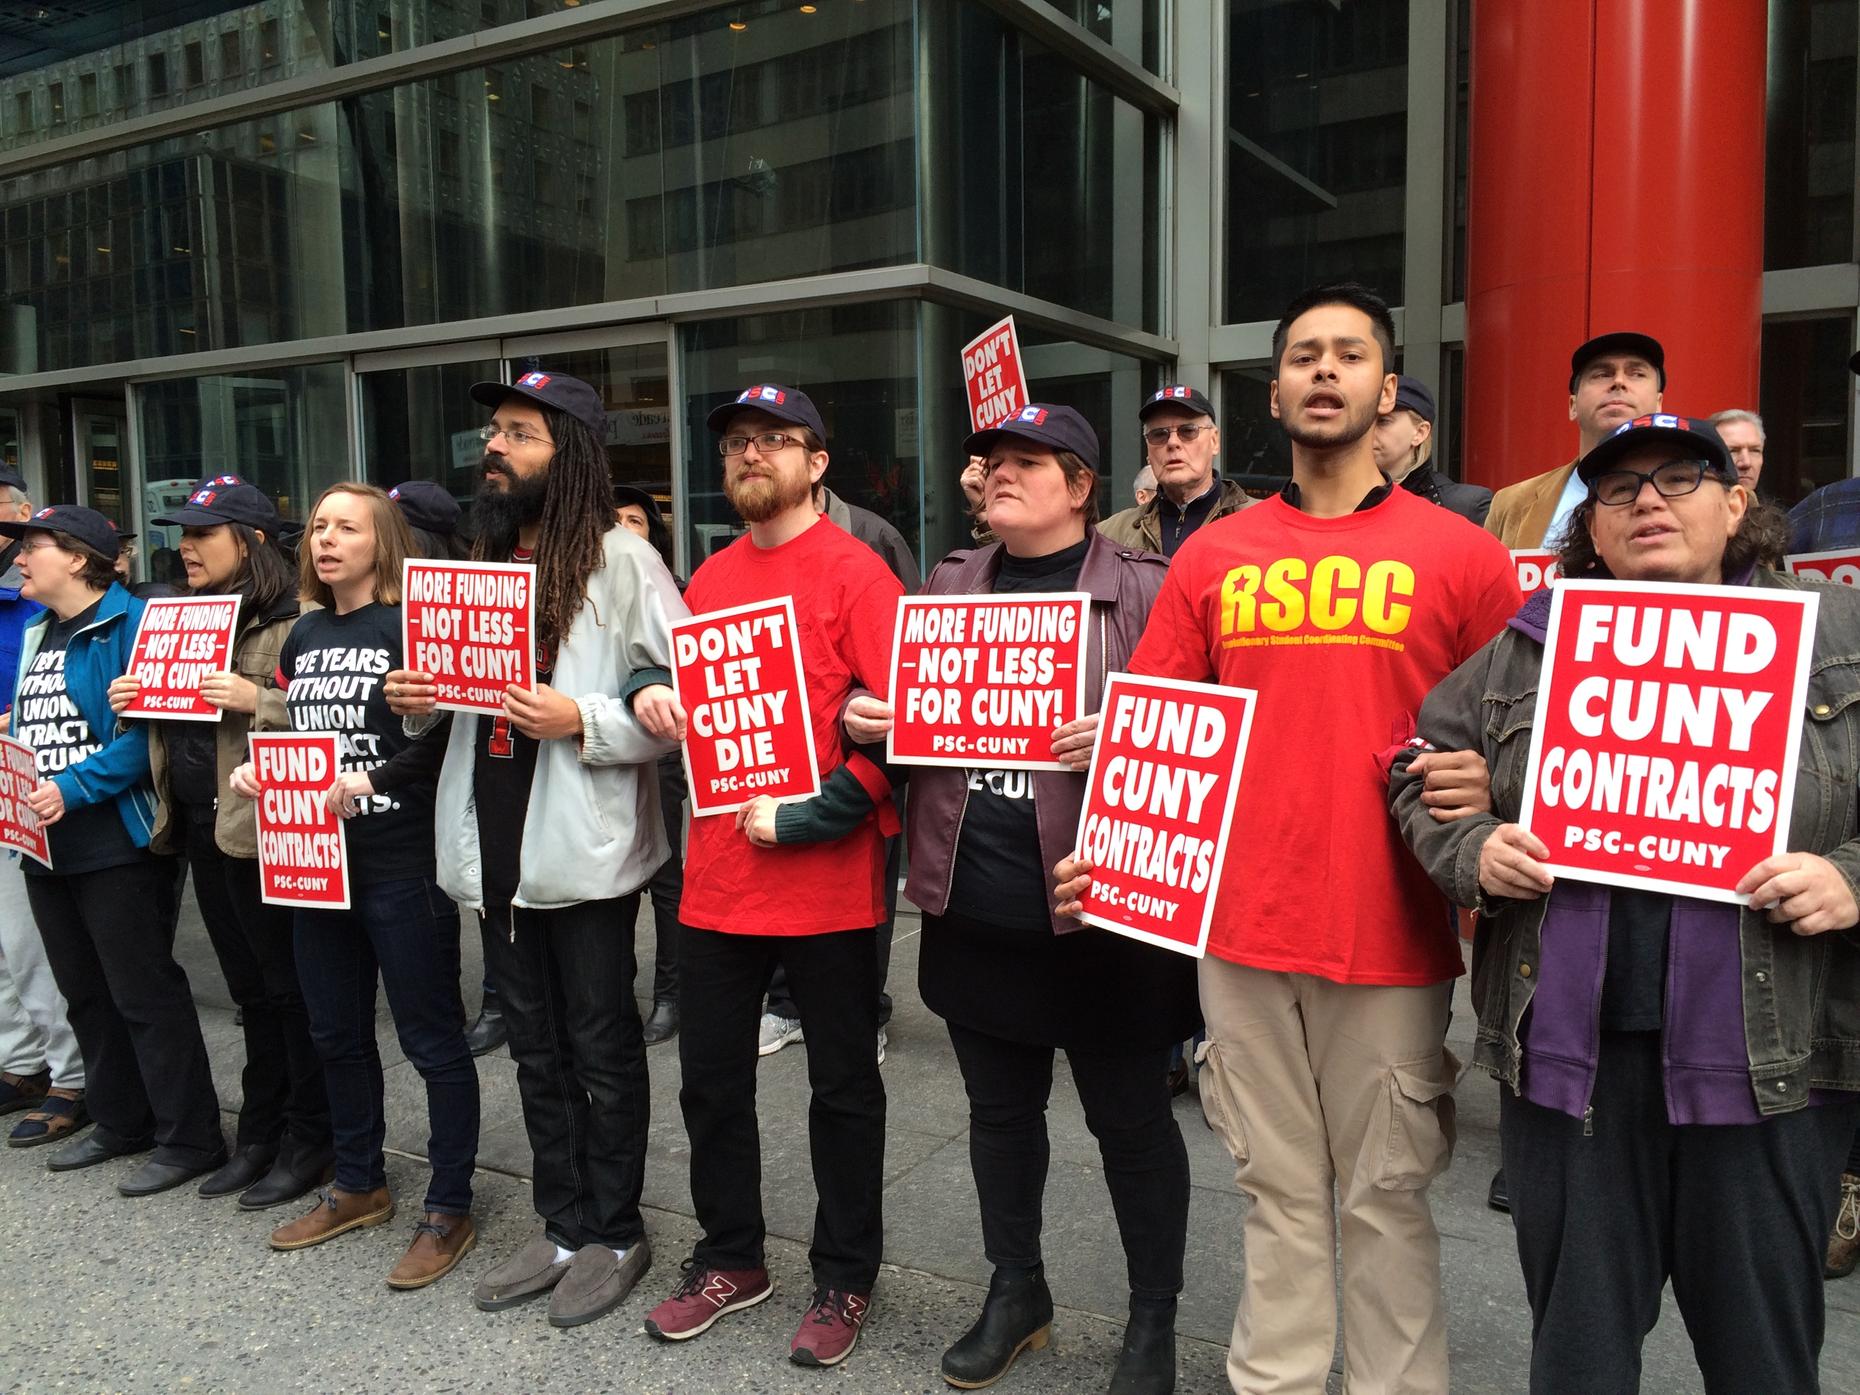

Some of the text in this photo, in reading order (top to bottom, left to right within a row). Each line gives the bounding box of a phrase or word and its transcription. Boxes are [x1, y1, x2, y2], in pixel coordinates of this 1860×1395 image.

[966, 330, 1010, 381] DON'T
[978, 364, 1002, 400] LET
[976, 385, 1016, 428] CUNY
[410, 570, 527, 609] MORE FUNDING
[1221, 556, 1415, 636] RSCC
[143, 604, 232, 631] MORE FUNDING
[904, 605, 1076, 643] MORE FUNDING
[676, 613, 784, 667] DON'T
[1574, 604, 1777, 674] FUND
[135, 662, 165, 688] FOR
[321, 648, 390, 674] YEARS
[416, 642, 455, 675] FOR
[460, 646, 522, 682] CUNY!
[704, 656, 762, 699] LET
[24, 695, 78, 721] UNION
[143, 696, 195, 710] PSC-CUNY
[438, 684, 502, 703] PSC-CUNY
[906, 688, 1063, 728] FOR CUNY!
[295, 705, 365, 731] UNION
[693, 690, 788, 737] CUNY
[1111, 694, 1226, 758] FUND
[1568, 676, 1774, 752] CUNY
[259, 747, 327, 782] FUND
[715, 731, 776, 772] DIE
[933, 735, 1030, 755] PSC-CUNY
[711, 768, 790, 794] PSC-CUNY
[1103, 755, 1219, 824] CUNY
[1540, 746, 1778, 834] CONTRACTS
[264, 789, 329, 826] CUNY
[352, 792, 400, 817] TS.
[262, 831, 340, 870] CONTRACTS
[1084, 813, 1214, 894] CONTRACTS
[1564, 826, 1731, 869] PSC-CUNY
[274, 875, 328, 892] PSC-CUNY
[1090, 880, 1179, 922] PSC-CUNY
